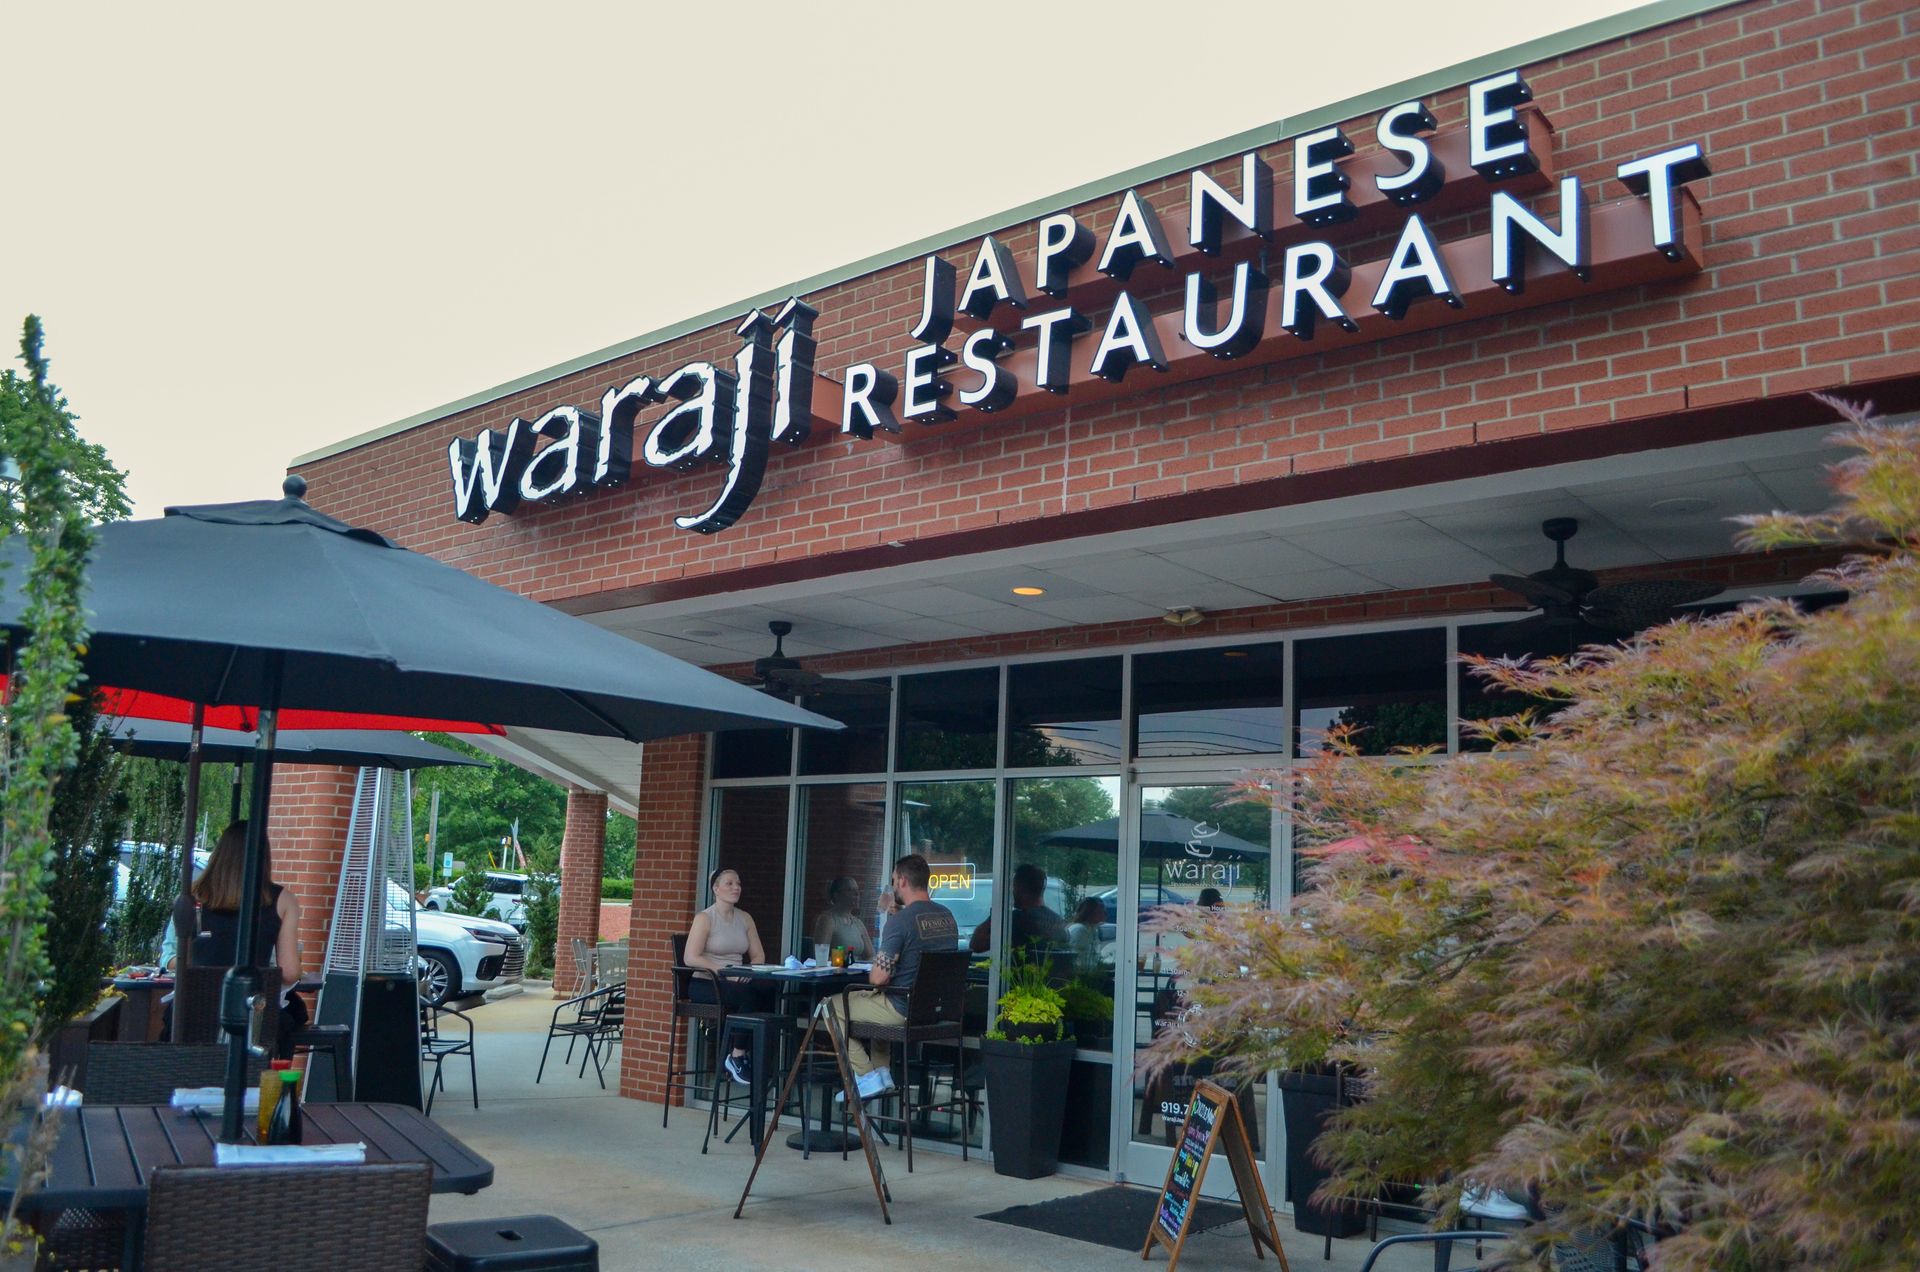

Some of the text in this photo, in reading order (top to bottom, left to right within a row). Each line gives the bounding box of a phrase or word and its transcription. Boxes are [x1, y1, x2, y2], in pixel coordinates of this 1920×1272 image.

[841, 143, 1708, 437] RESTAURANT
[911, 70, 1535, 341] JAPANESE
[448, 296, 814, 533] waraji
[928, 874, 970, 889] OPEN
[1165, 855, 1241, 898] waraji
